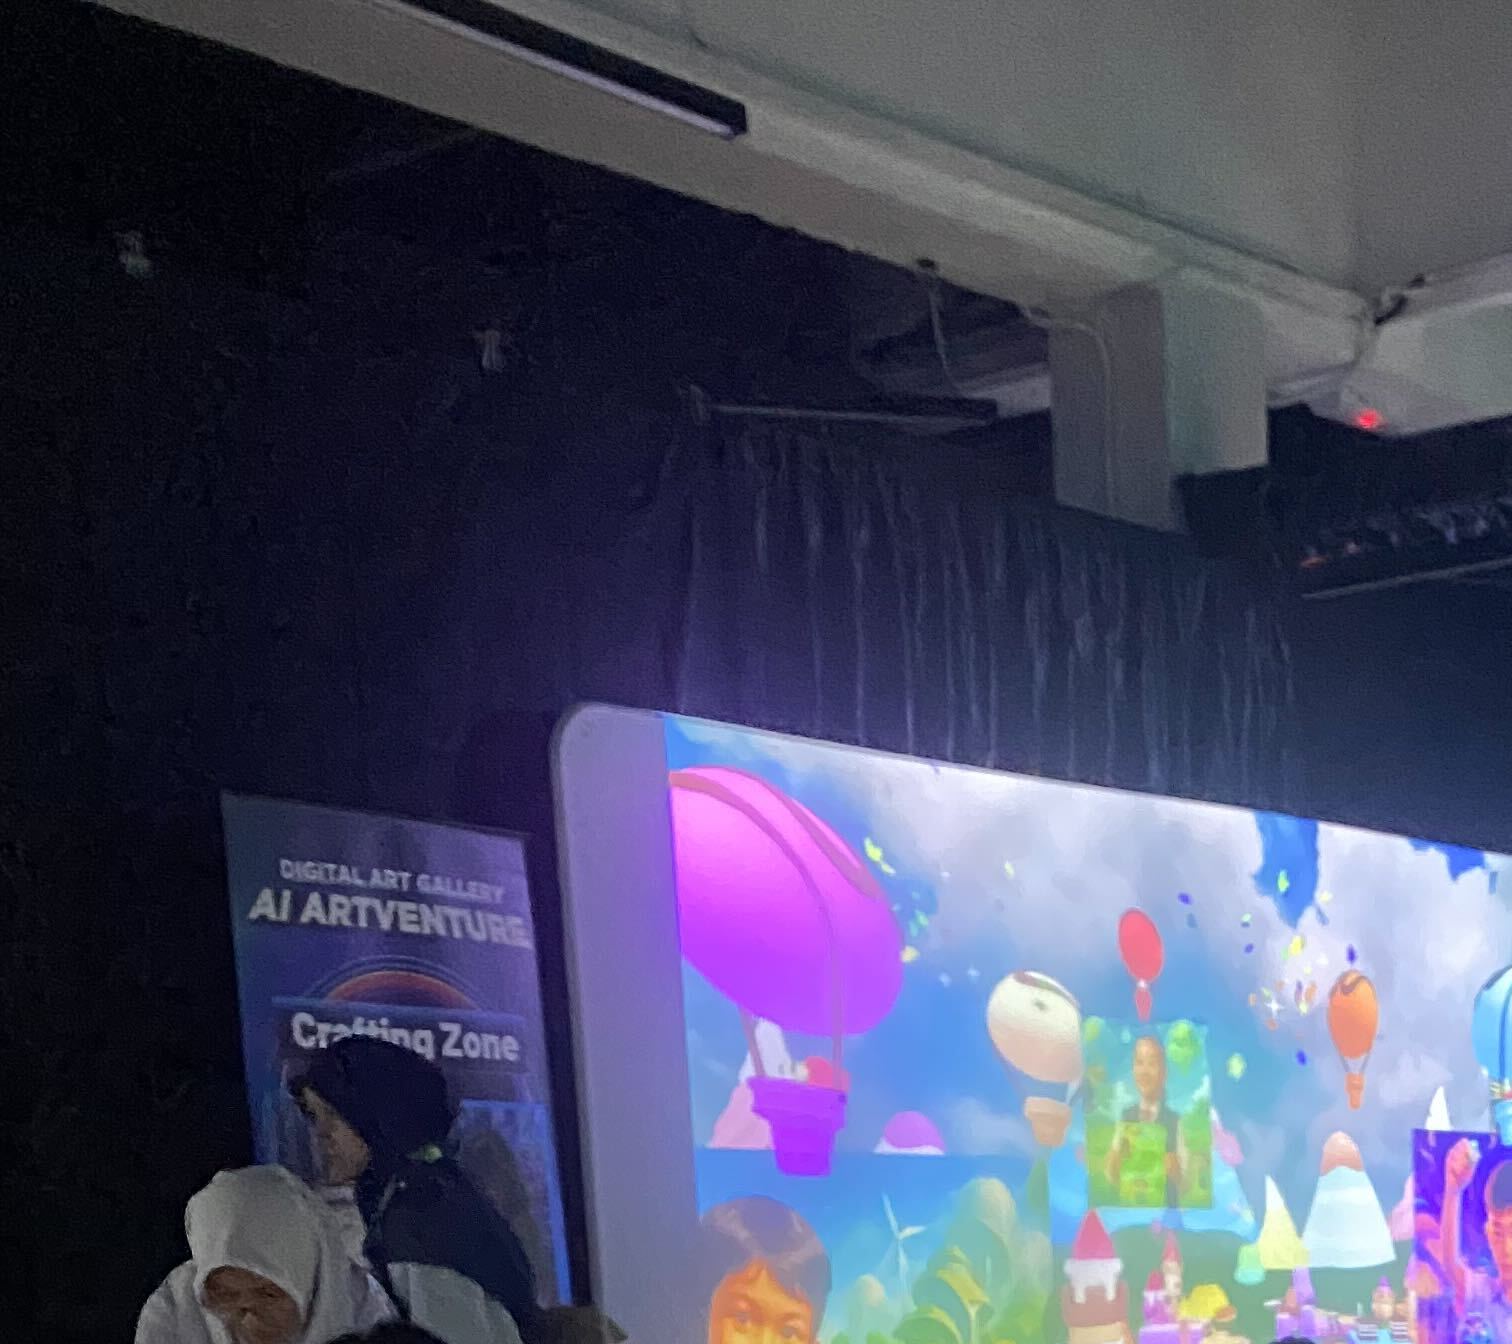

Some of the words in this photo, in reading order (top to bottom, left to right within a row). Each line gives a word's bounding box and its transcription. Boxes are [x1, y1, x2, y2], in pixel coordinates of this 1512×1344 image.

[279, 858, 361, 886] DIGITAL
[371, 869, 413, 893] ART
[416, 873, 504, 903] GALLERY
[249, 888, 293, 921] AI
[300, 892, 533, 948] ARTVENTURE
[441, 1023, 521, 1062] Zone
